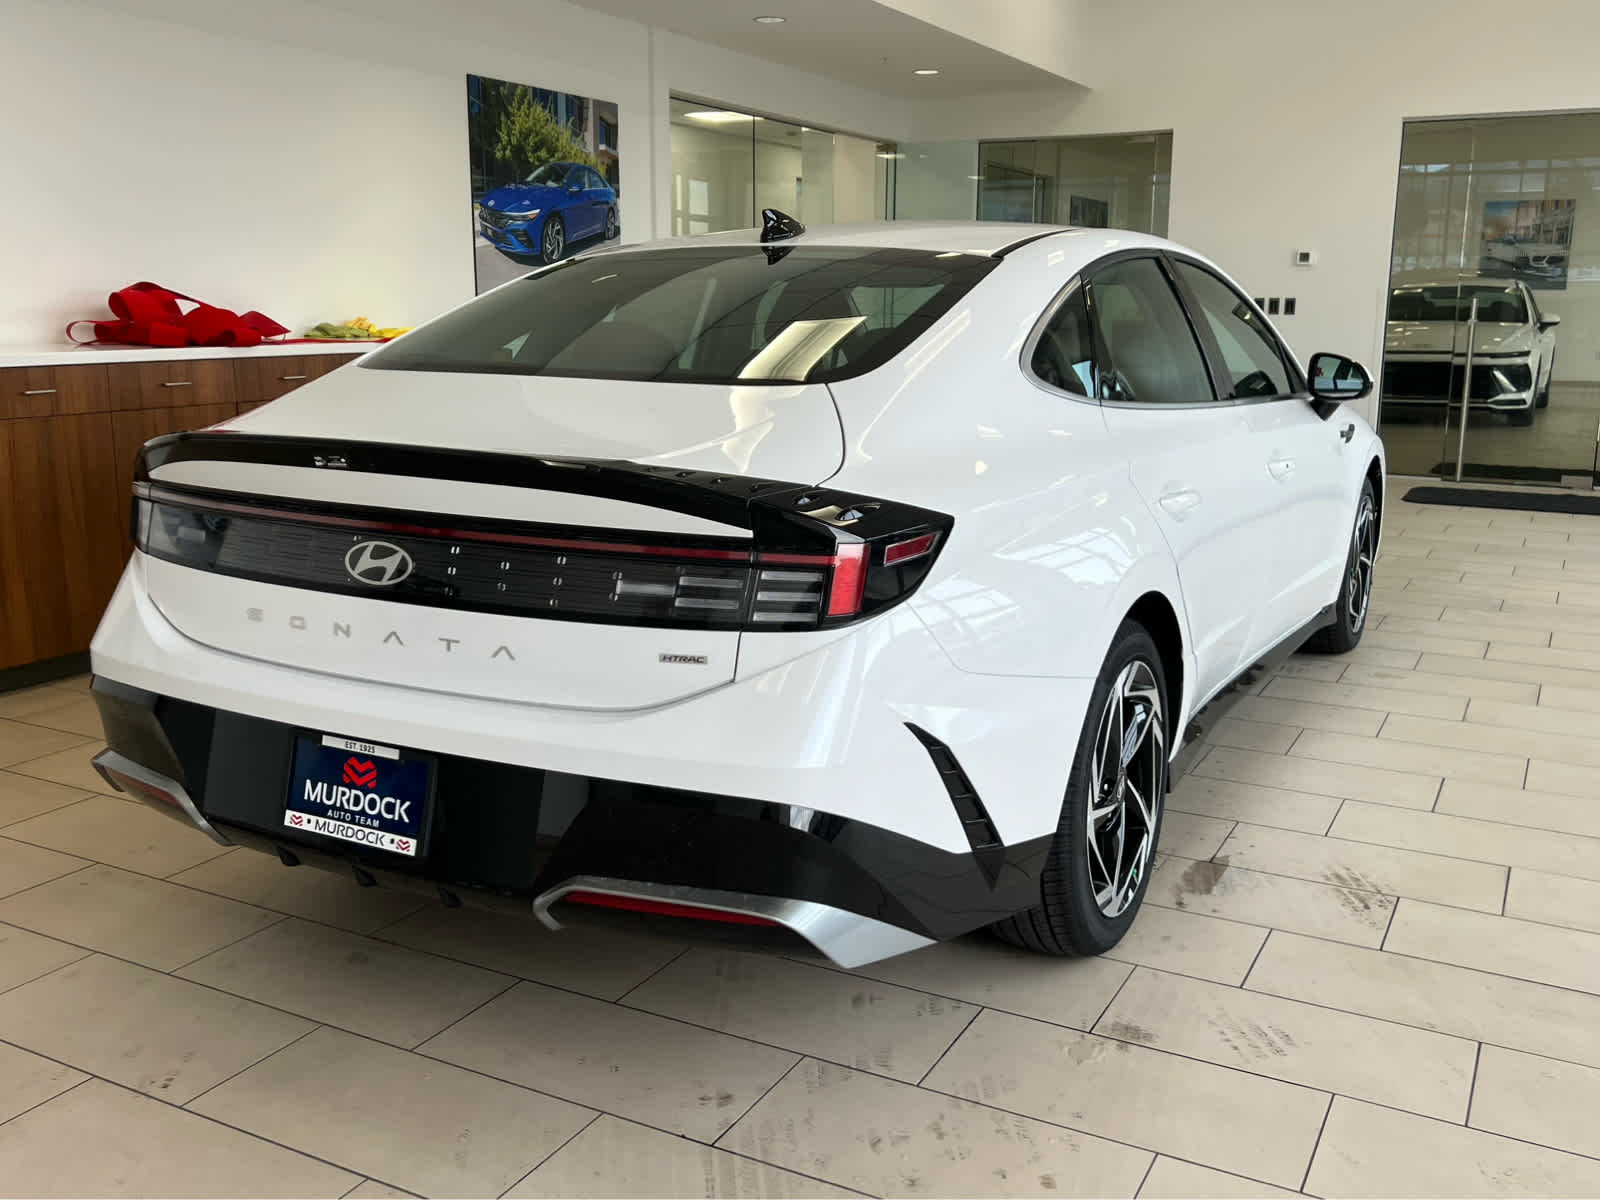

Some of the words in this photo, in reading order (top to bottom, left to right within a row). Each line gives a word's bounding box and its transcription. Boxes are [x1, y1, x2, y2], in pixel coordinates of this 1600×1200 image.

[246, 607, 516, 662] SONATA
[659, 654, 708, 665] HTRAC
[359, 743, 376, 754] 1925
[304, 779, 411, 823] MURDOCK
[327, 809, 352, 821] AUTO
[355, 815, 380, 828] TEAM
[314, 818, 385, 847] MURDOCK
